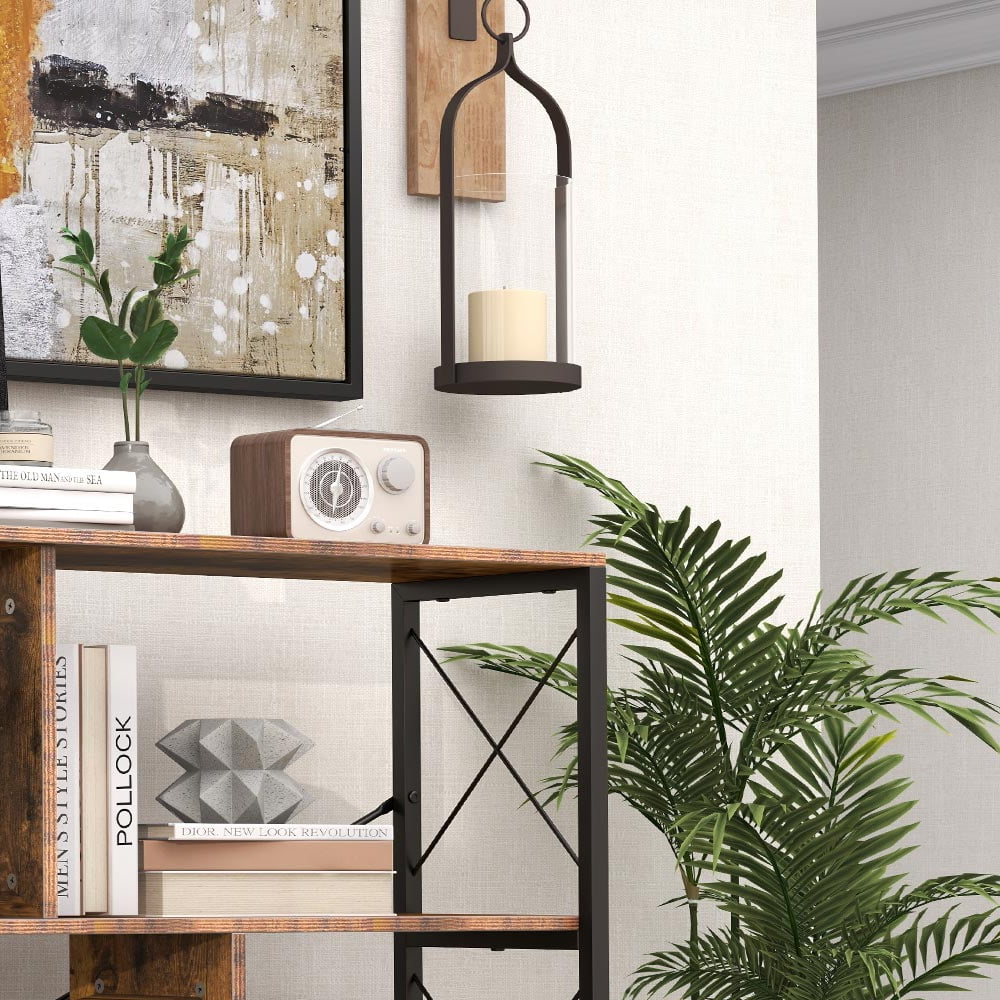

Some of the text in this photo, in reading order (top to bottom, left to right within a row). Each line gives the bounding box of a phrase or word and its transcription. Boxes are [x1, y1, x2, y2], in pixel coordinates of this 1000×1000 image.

[0, 470, 19, 481] THE
[20, 471, 39, 482] OLD
[40, 472, 60, 483] MAN
[86, 475, 103, 485] SEA
[115, 715, 133, 846] POLLOCK
[223, 827, 255, 837] NEW
[259, 827, 296, 837] LOOK
[301, 828, 388, 838] REVOLUTION
